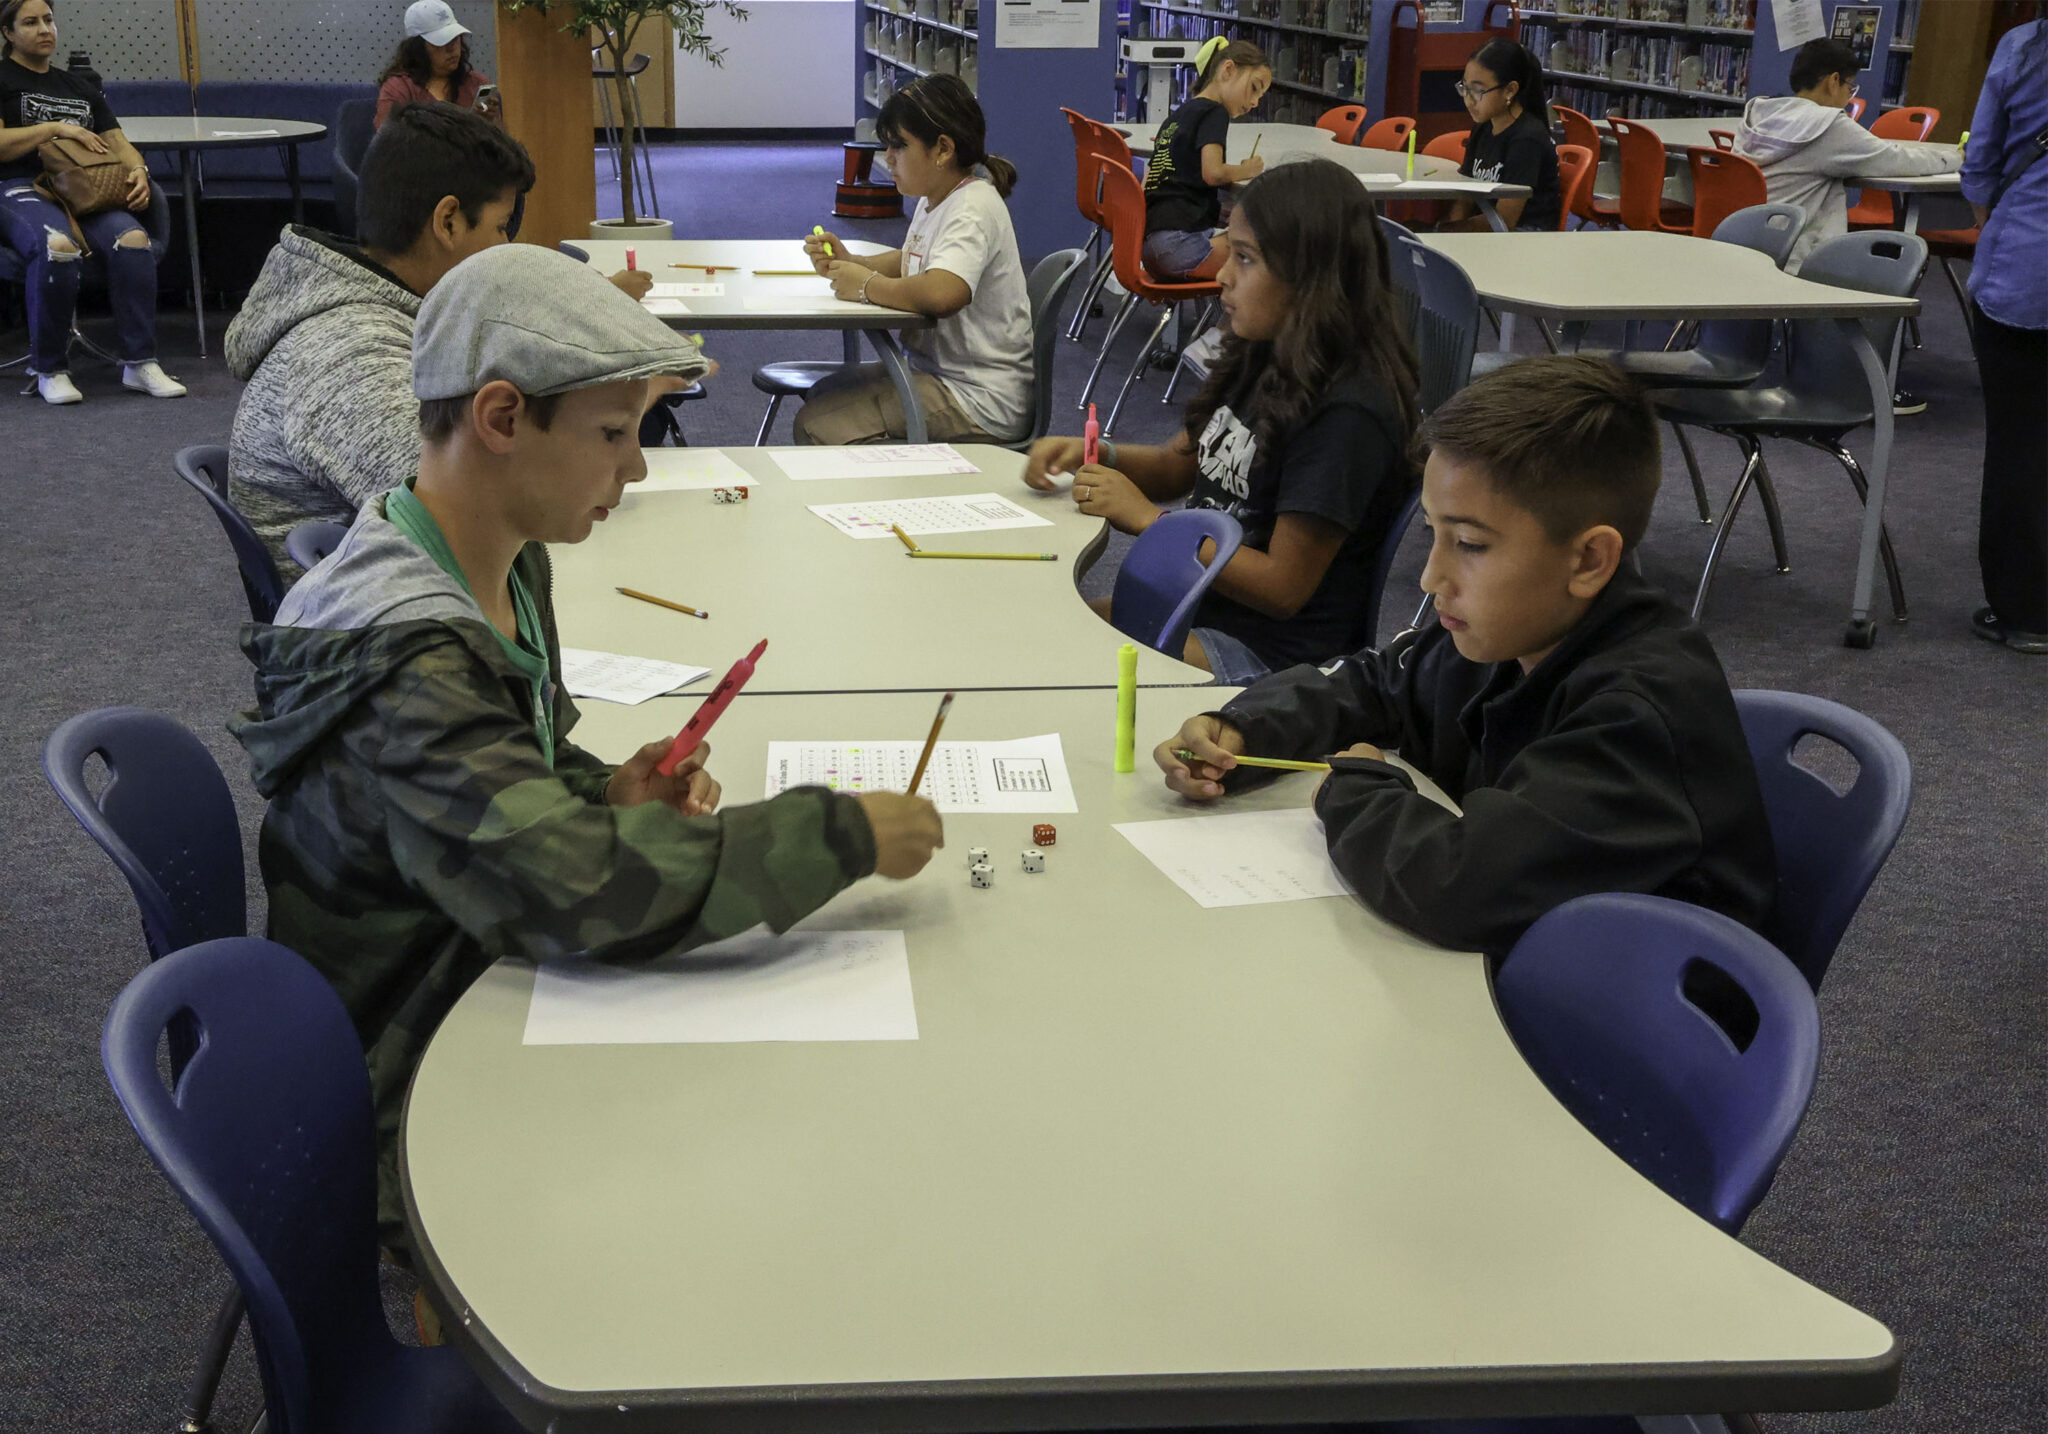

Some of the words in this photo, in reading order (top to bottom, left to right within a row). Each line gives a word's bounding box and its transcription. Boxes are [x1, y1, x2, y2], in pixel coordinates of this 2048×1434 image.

[1838, 12, 1849, 20] THE
[1836, 20, 1850, 28] LAST
[1834, 28, 1843, 36] OF
[1843, 28, 1852, 36] US
